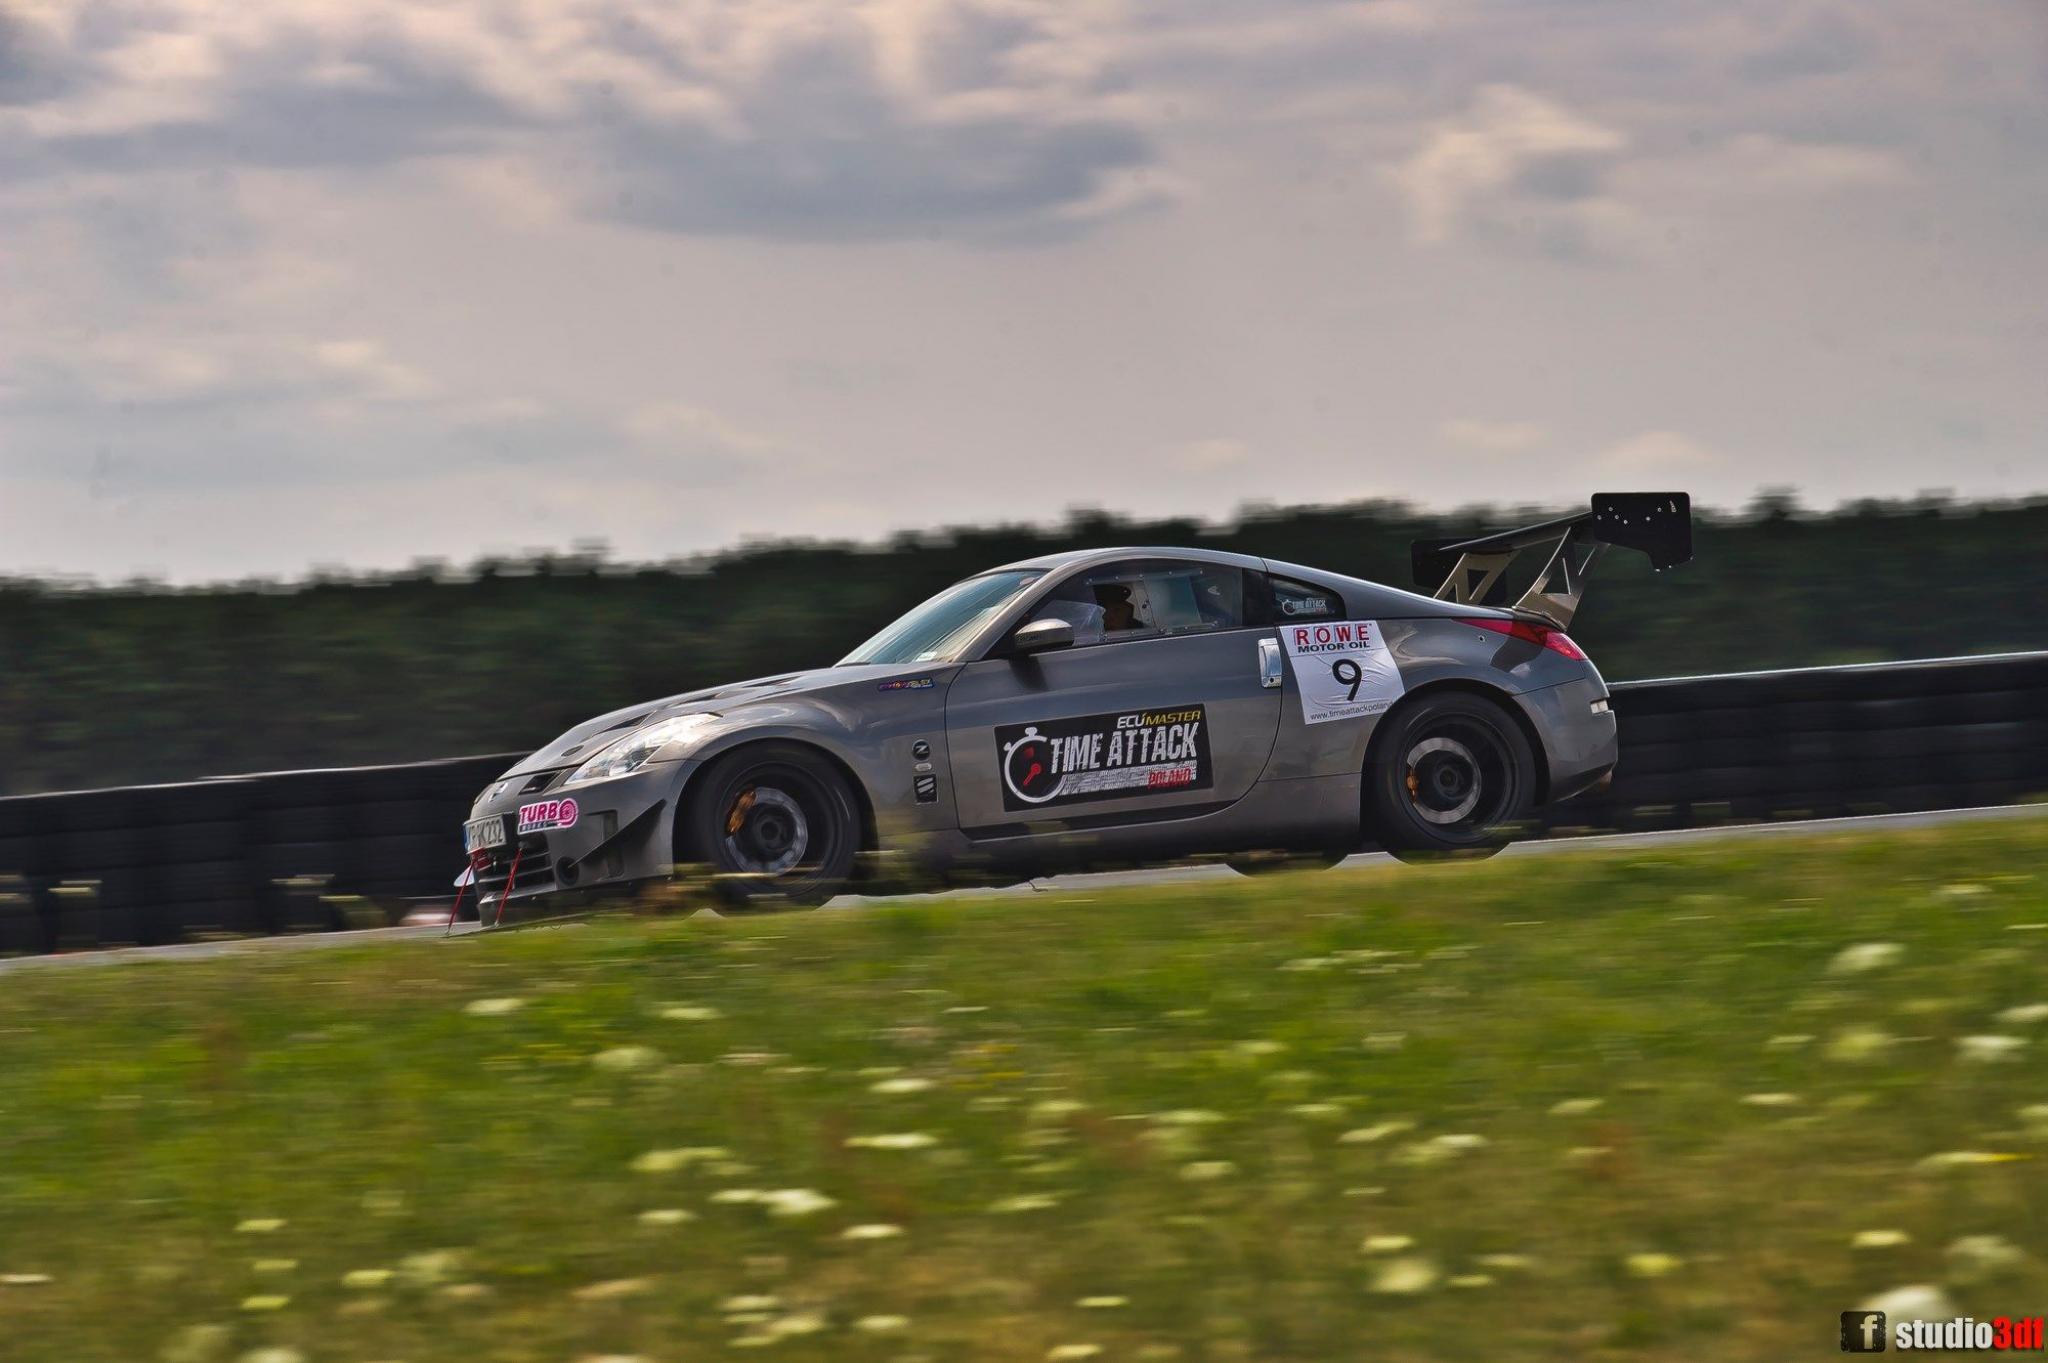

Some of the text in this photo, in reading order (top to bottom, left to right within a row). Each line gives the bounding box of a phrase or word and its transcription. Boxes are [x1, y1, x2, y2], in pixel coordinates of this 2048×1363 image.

[1294, 624, 1370, 646] ROWE
[1298, 641, 1371, 653] MOTOR OIL
[1332, 659, 1362, 702] 9
[1050, 722, 1199, 774] TIME ATTACK
[1148, 768, 1192, 788] POLAND
